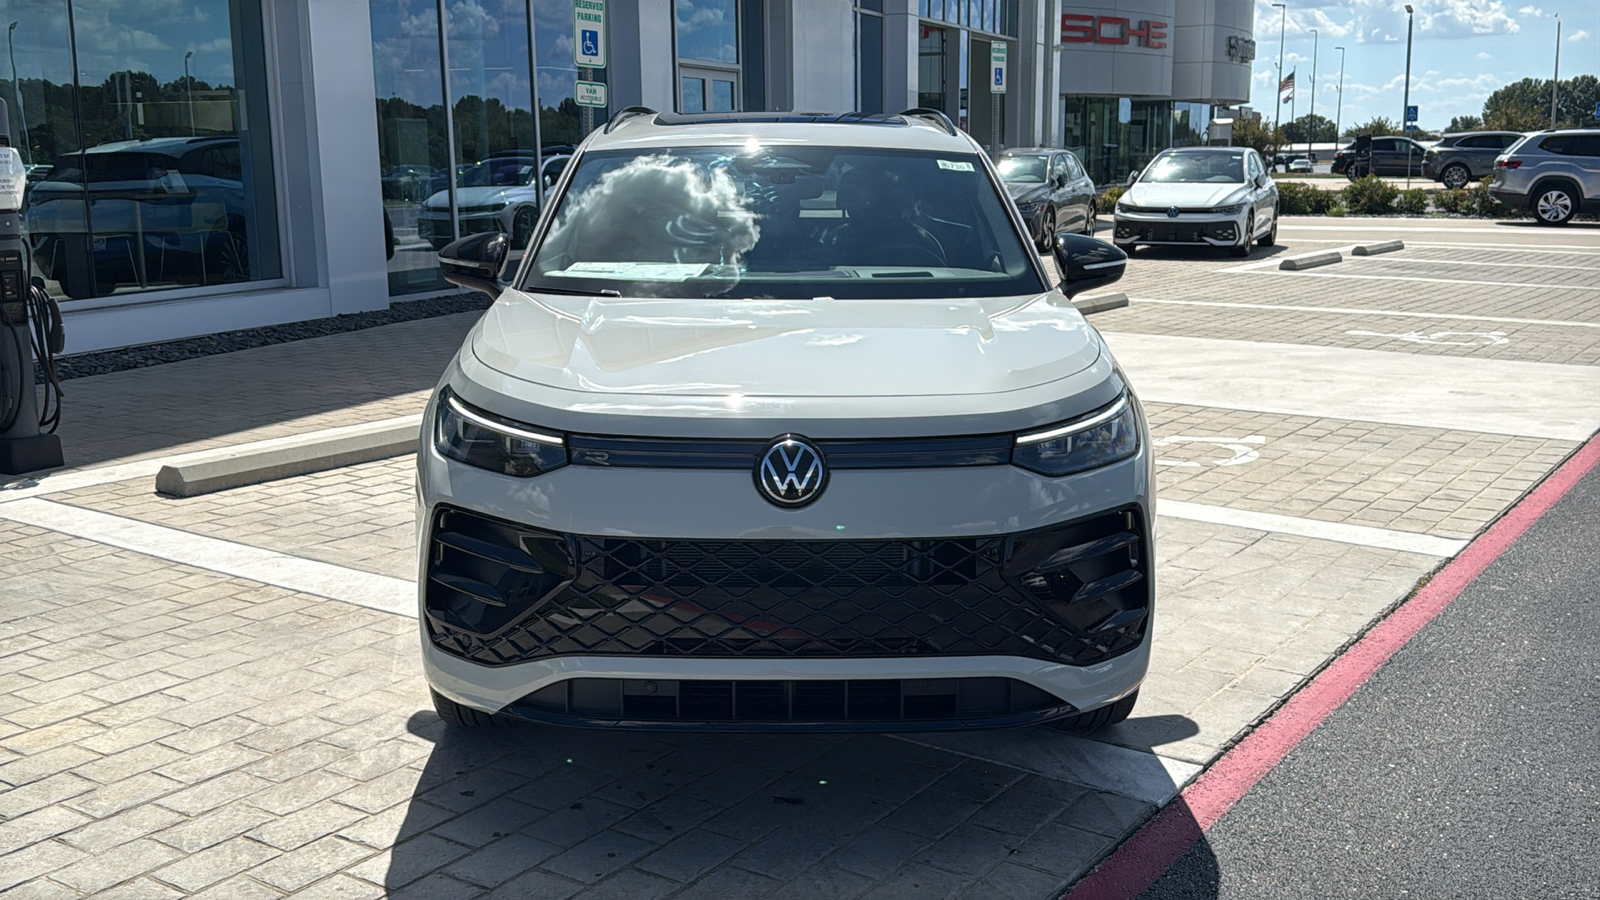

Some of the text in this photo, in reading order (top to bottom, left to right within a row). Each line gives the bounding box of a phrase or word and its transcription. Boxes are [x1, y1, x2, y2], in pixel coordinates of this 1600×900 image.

[575, 0, 603, 11] RESERVED
[577, 11, 602, 23] PARKING
[585, 87, 597, 95] VAN
